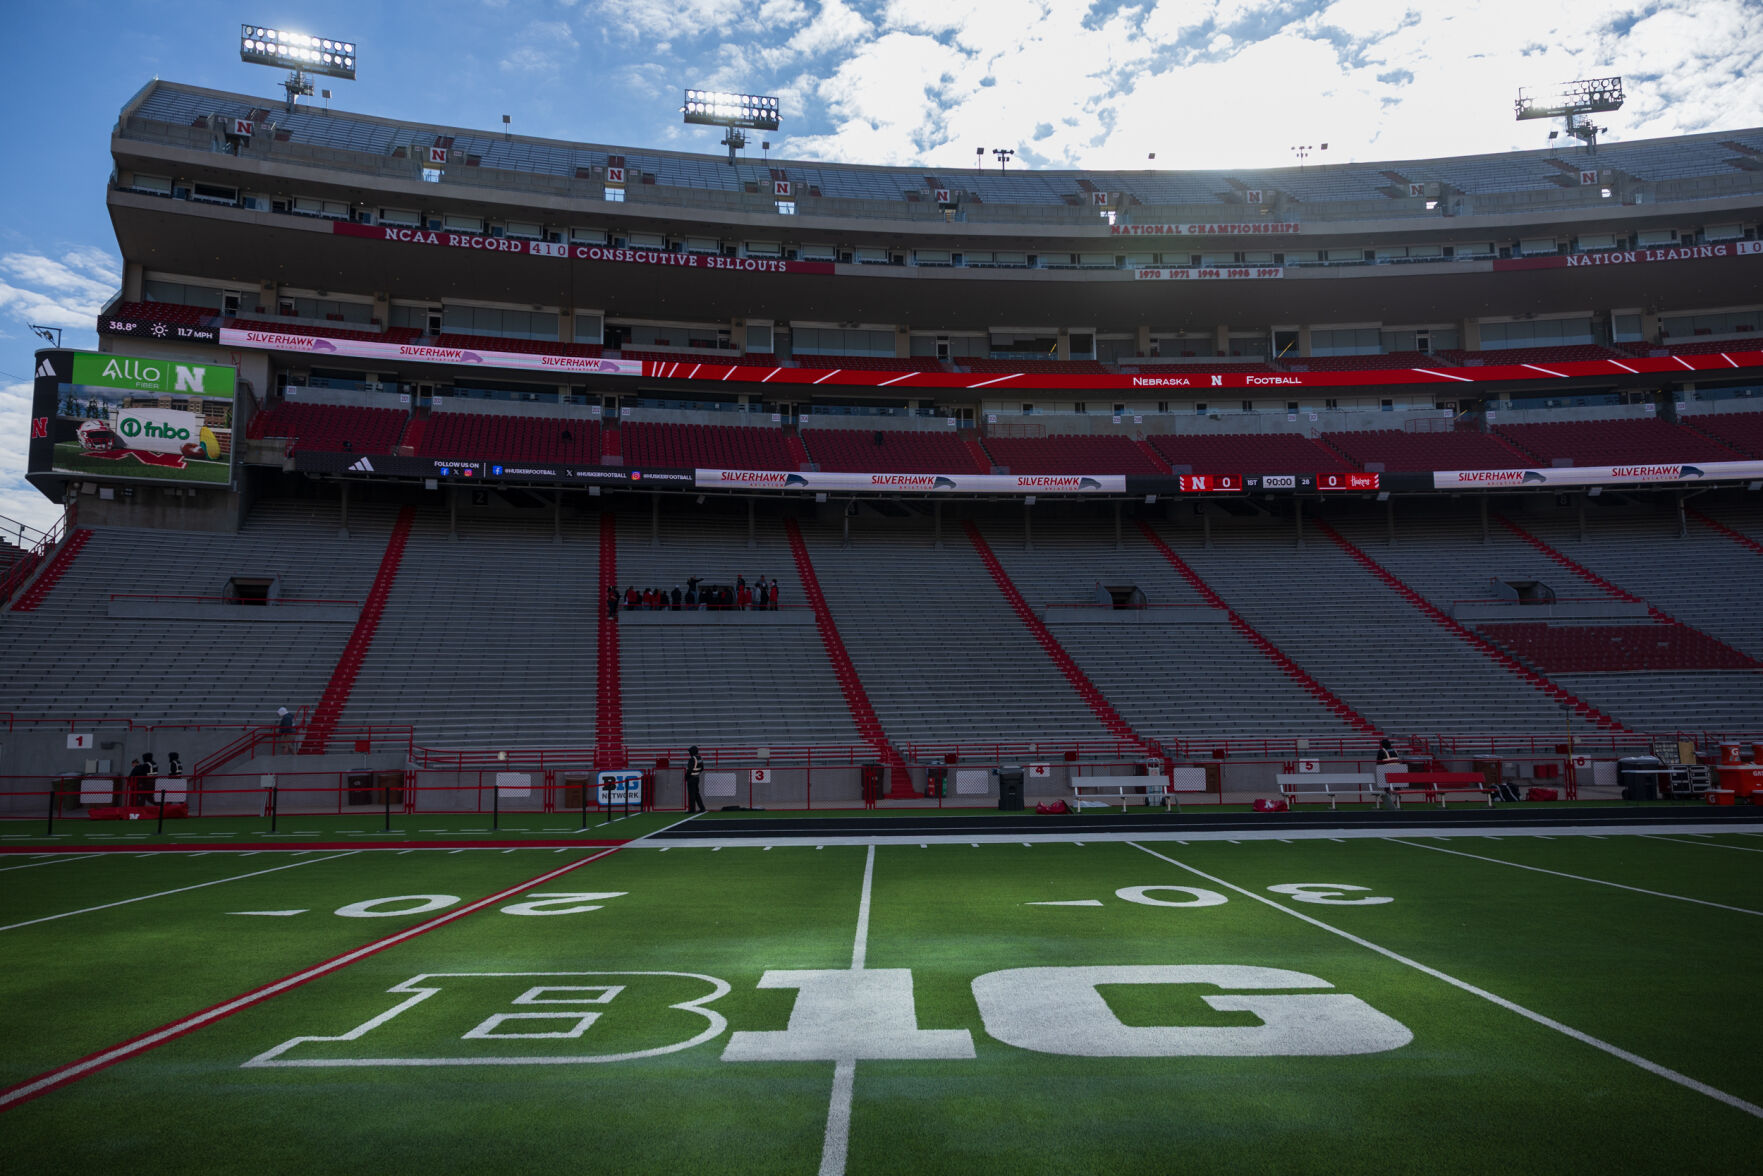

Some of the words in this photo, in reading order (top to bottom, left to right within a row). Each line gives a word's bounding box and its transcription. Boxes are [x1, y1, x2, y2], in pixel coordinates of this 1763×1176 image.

[237, 121, 251, 134] N
[432, 150, 445, 161] N
[610, 170, 622, 180] N
[1583, 172, 1595, 183] N
[777, 183, 788, 193] N
[937, 191, 948, 201] N
[1249, 192, 1260, 202] N
[1111, 225, 1182, 234] NATIONAL
[1188, 223, 1300, 233] CHAMPIONSHIPS
[385, 228, 439, 245] NCAA
[449, 235, 522, 252] RECORD
[532, 242, 567, 256] 410
[576, 247, 697, 267] CONSECUTIVE
[707, 257, 787, 271] SELLOUTS
[1567, 252, 1637, 267] NATION
[1646, 245, 1727, 261] LEADING
[177, 327, 193, 337] 11.7
[194, 331, 213, 339] MPH
[247, 333, 314, 346] SILVERHAWK
[400, 346, 462, 358] SILVERHAWK
[541, 357, 600, 368] SILVERHAWK
[174, 365, 206, 393] N
[1133, 377, 1190, 386] NEBRASKA
[1211, 375, 1222, 386] N
[1246, 376, 1302, 385] FOOTBALL
[32, 417, 48, 438] N
[144, 421, 190, 440] fnbo
[721, 472, 786, 482] SILVERHAWK
[1458, 471, 1523, 481] SILVERHAWK
[1612, 466, 1680, 477] SILVERHAWK
[872, 475, 935, 485] SILVERHAWK
[1018, 477, 1080, 487] SILVERHAWK
[1192, 476, 1206, 490] N
[1222, 477, 1231, 488] 0
[1266, 478, 1292, 486] 90:00
[1328, 475, 1337, 486] 0
[76, 736, 83, 746] 1
[1305, 761, 1314, 771] 5
[755, 770, 765, 780] 3
[602, 791, 639, 800] NTWRK
